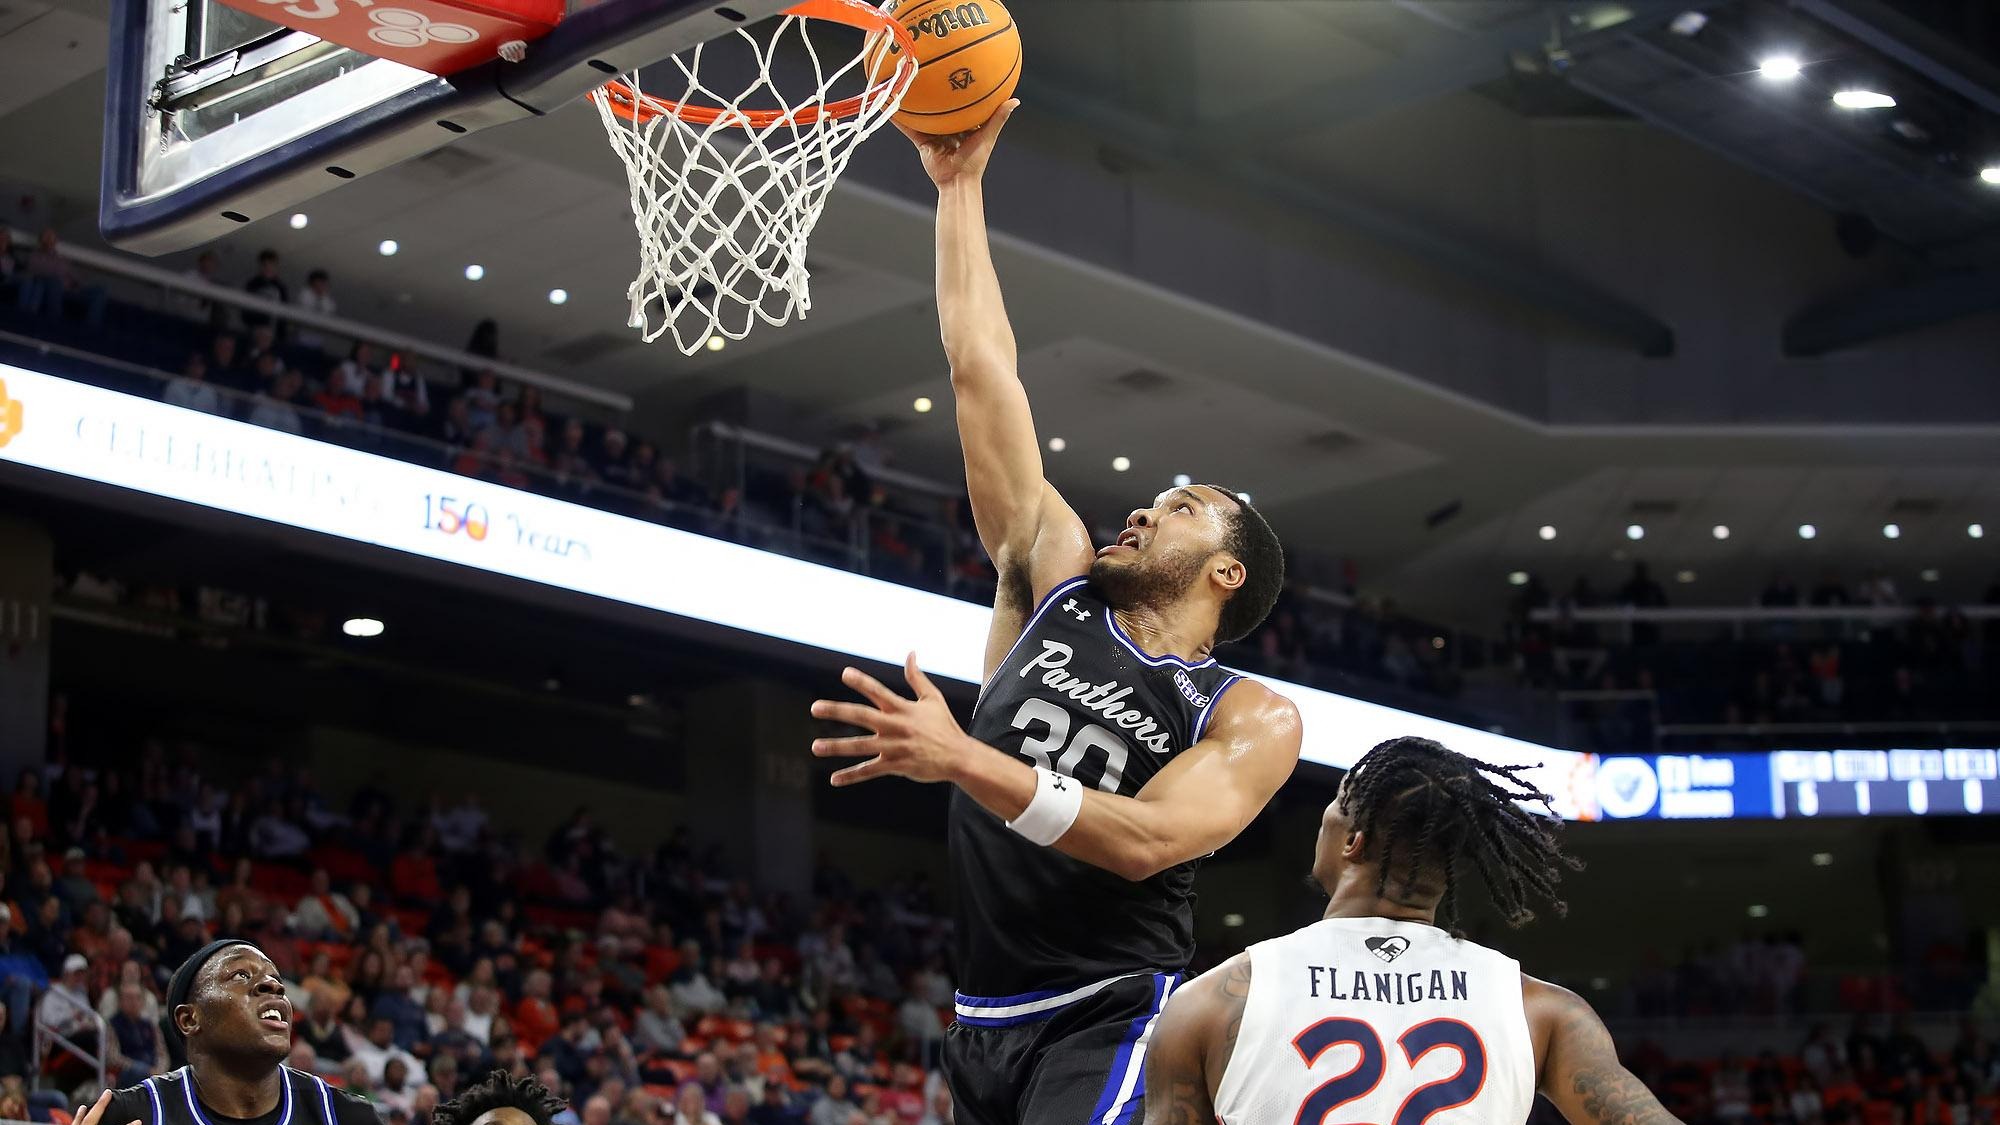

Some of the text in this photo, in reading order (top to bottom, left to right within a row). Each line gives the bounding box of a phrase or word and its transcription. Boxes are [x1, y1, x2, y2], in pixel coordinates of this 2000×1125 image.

[895, 2, 990, 50] Wils
[424, 494, 489, 541] 150
[1019, 639, 1170, 753] Panthers
[1010, 698, 1129, 795] 30
[1308, 966, 1468, 1005] FLANIGAN
[1292, 1017, 1488, 1125] 22
